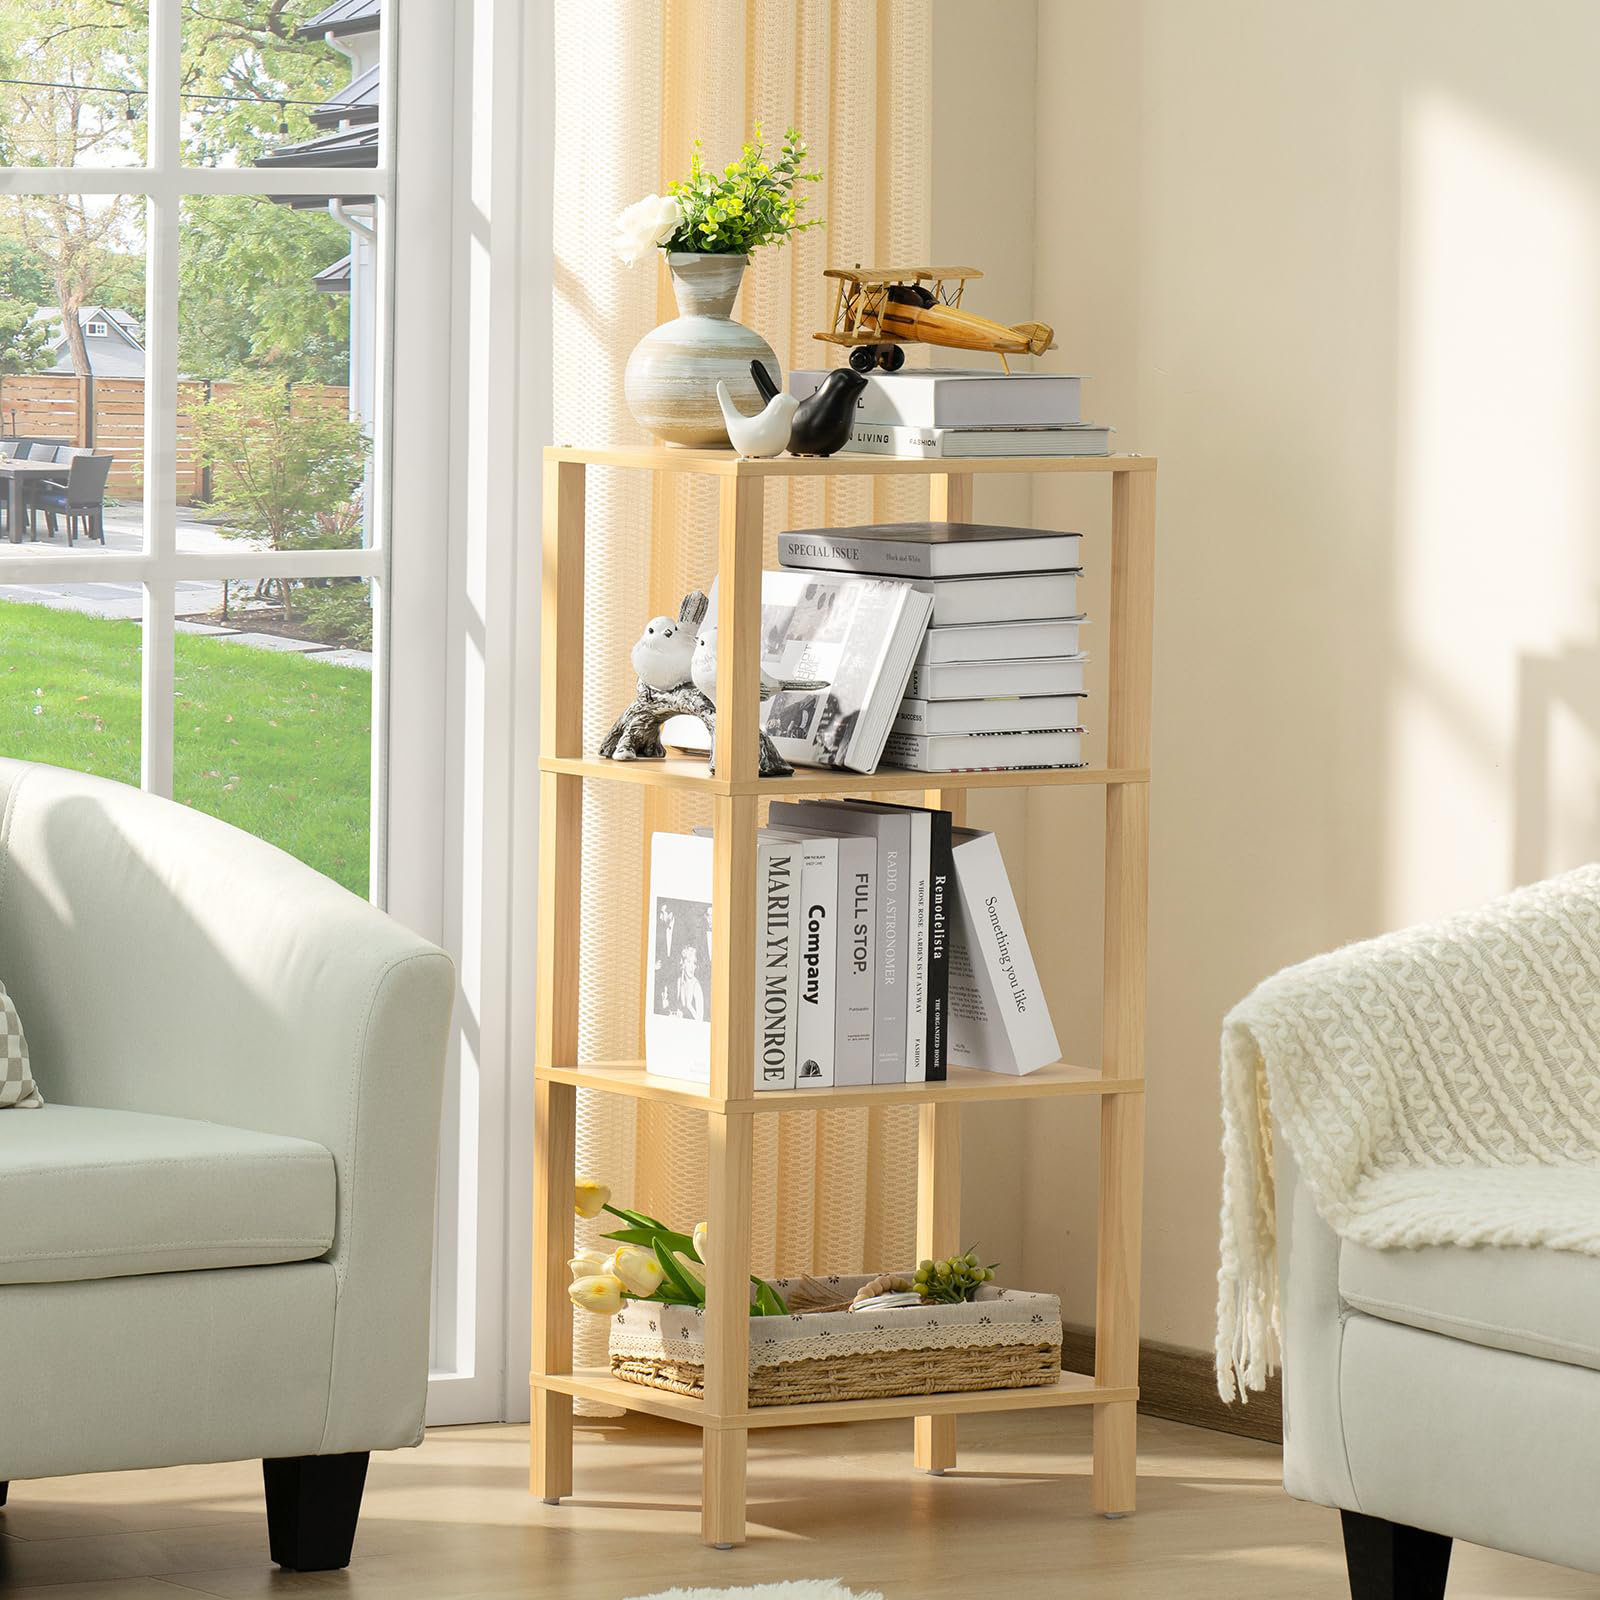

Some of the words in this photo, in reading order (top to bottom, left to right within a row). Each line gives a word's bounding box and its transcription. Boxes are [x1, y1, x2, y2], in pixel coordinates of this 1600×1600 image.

[857, 433, 889, 444] LIVING
[908, 438, 936, 447] FASHION
[788, 543, 829, 558] SPECIAL
[832, 547, 859, 560] ISSUE
[901, 713, 922, 722] SUCCESS
[886, 851, 898, 892] RADIO
[917, 880, 925, 907] WHOSE
[766, 856, 791, 969] MARILYN
[853, 873, 869, 920] FULL
[933, 876, 947, 960] Remodelista
[803, 904, 826, 1005] Company
[853, 924, 868, 976] STOP.
[884, 897, 897, 985] ASTRONOMER
[985, 896, 1012, 966] Something
[1001, 965, 1019, 989] you
[1013, 988, 1028, 1014] like
[916, 972, 923, 980] IT
[917, 963, 923, 971] IS
[763, 975, 787, 1082] MONROE
